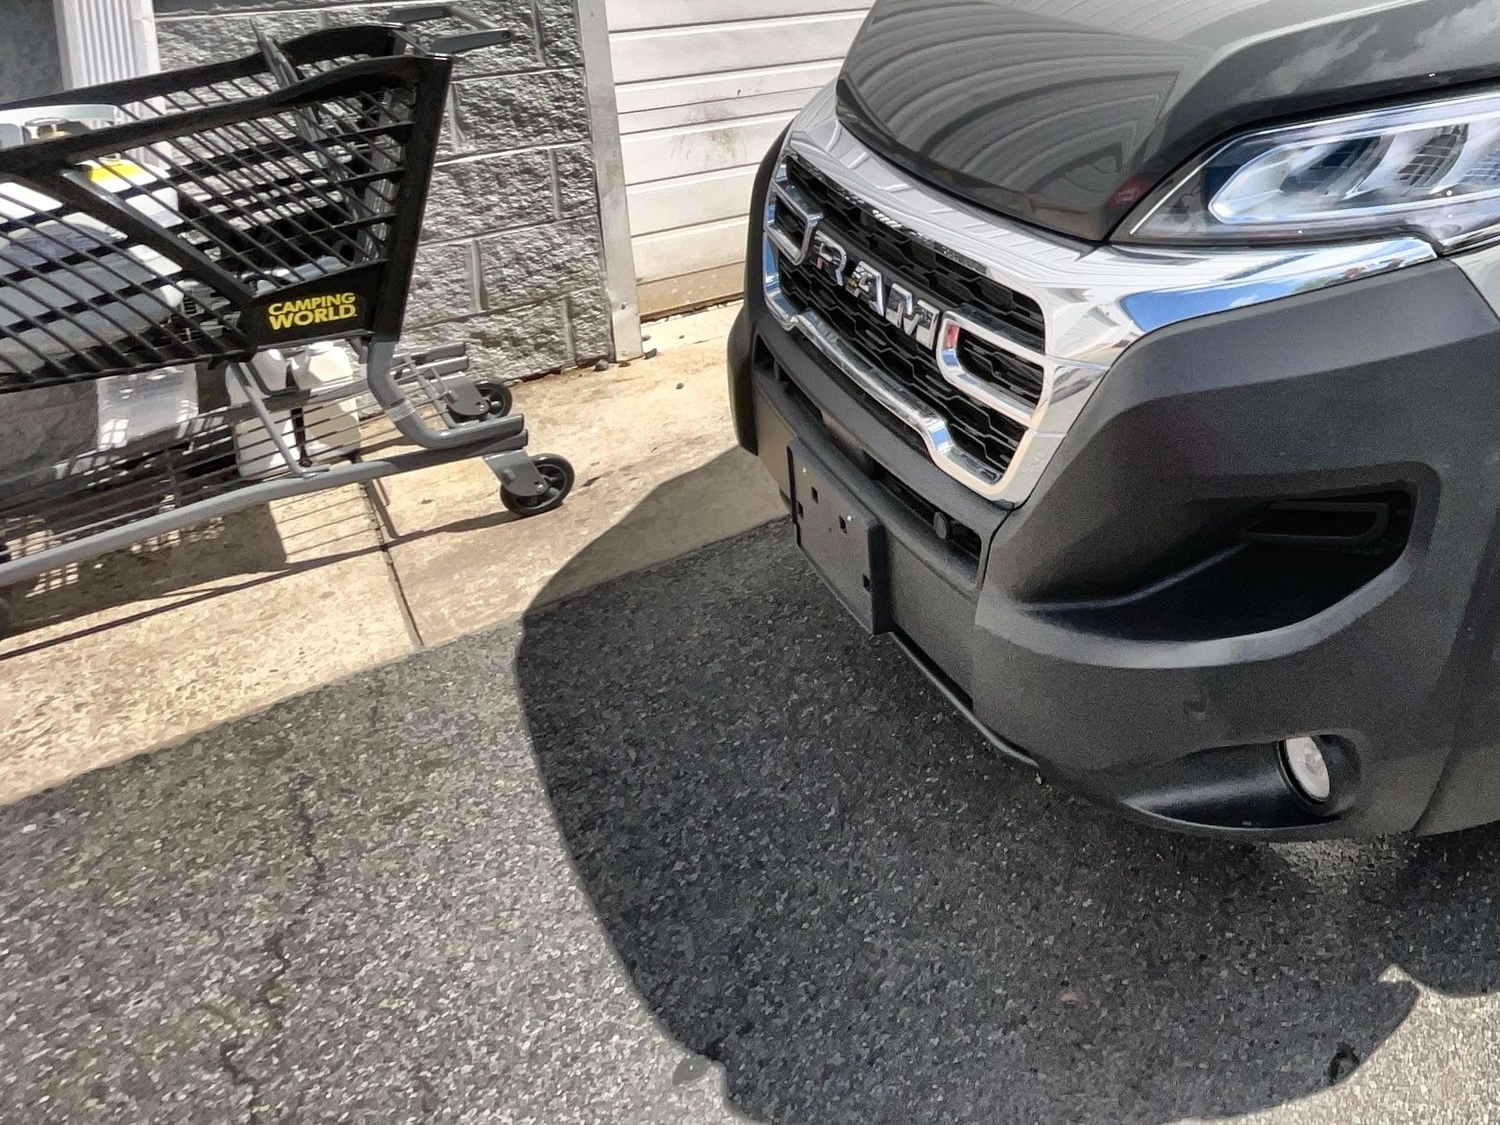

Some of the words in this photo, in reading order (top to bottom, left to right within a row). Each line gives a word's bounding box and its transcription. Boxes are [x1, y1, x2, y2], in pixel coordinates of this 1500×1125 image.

[268, 292, 356, 315] CAMPING
[814, 230, 940, 351] RAM
[268, 304, 357, 330] WORLD
